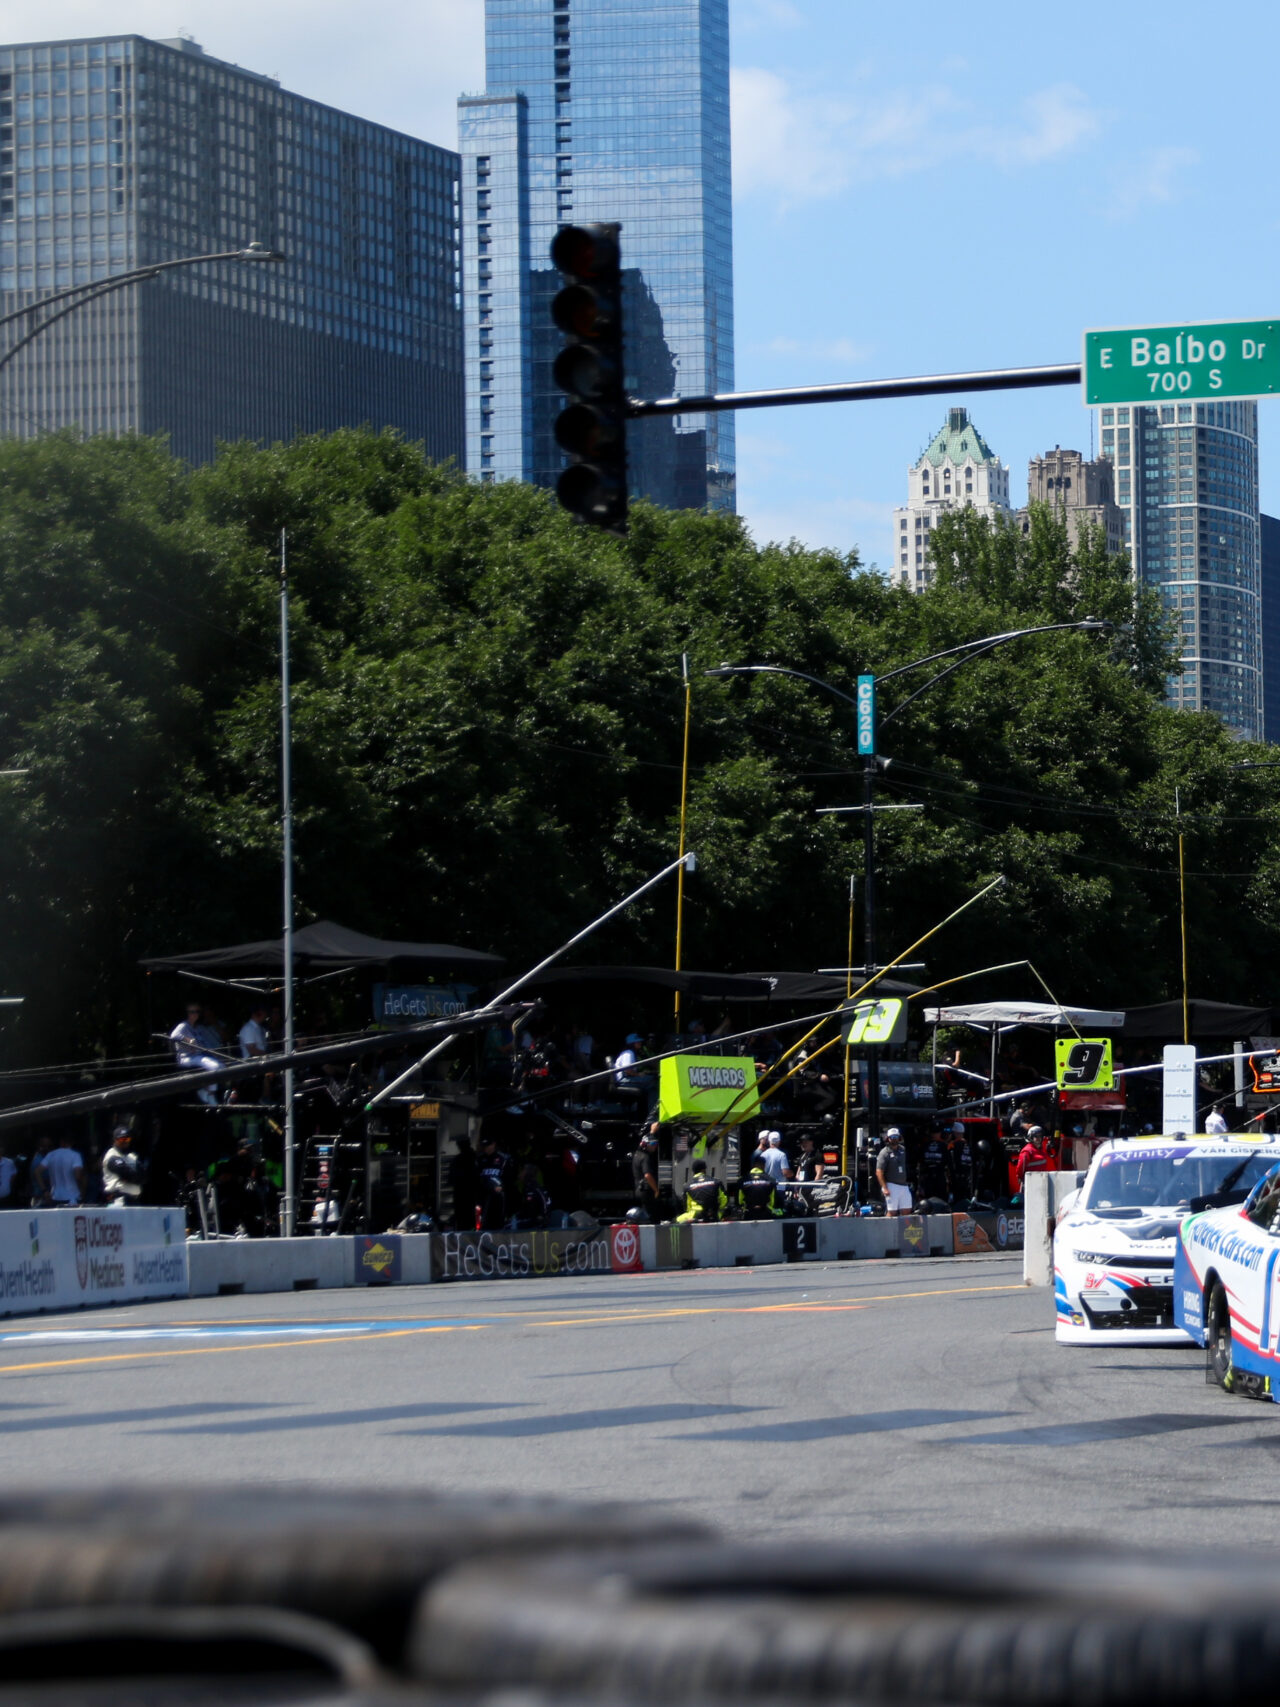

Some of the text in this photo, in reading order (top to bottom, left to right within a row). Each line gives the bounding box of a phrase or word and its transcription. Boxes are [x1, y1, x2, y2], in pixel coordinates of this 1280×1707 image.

[1101, 335, 1266, 368] E Balbo Dr
[1147, 369, 1222, 393] 700 S
[858, 683, 872, 746] C620
[384, 993, 466, 1016] HeGetsUs.com
[848, 998, 902, 1043] 19
[689, 1066, 745, 1088] MENARDS
[1063, 1042, 1106, 1085] 9
[1114, 1148, 1175, 1161] xfinity
[89, 1217, 123, 1252] UChicago
[796, 1225, 806, 1249] 2
[133, 1252, 183, 1285] AdventHealth
[442, 1232, 611, 1277] HeGetsUs.com
[90, 1256, 125, 1288] Medicine
